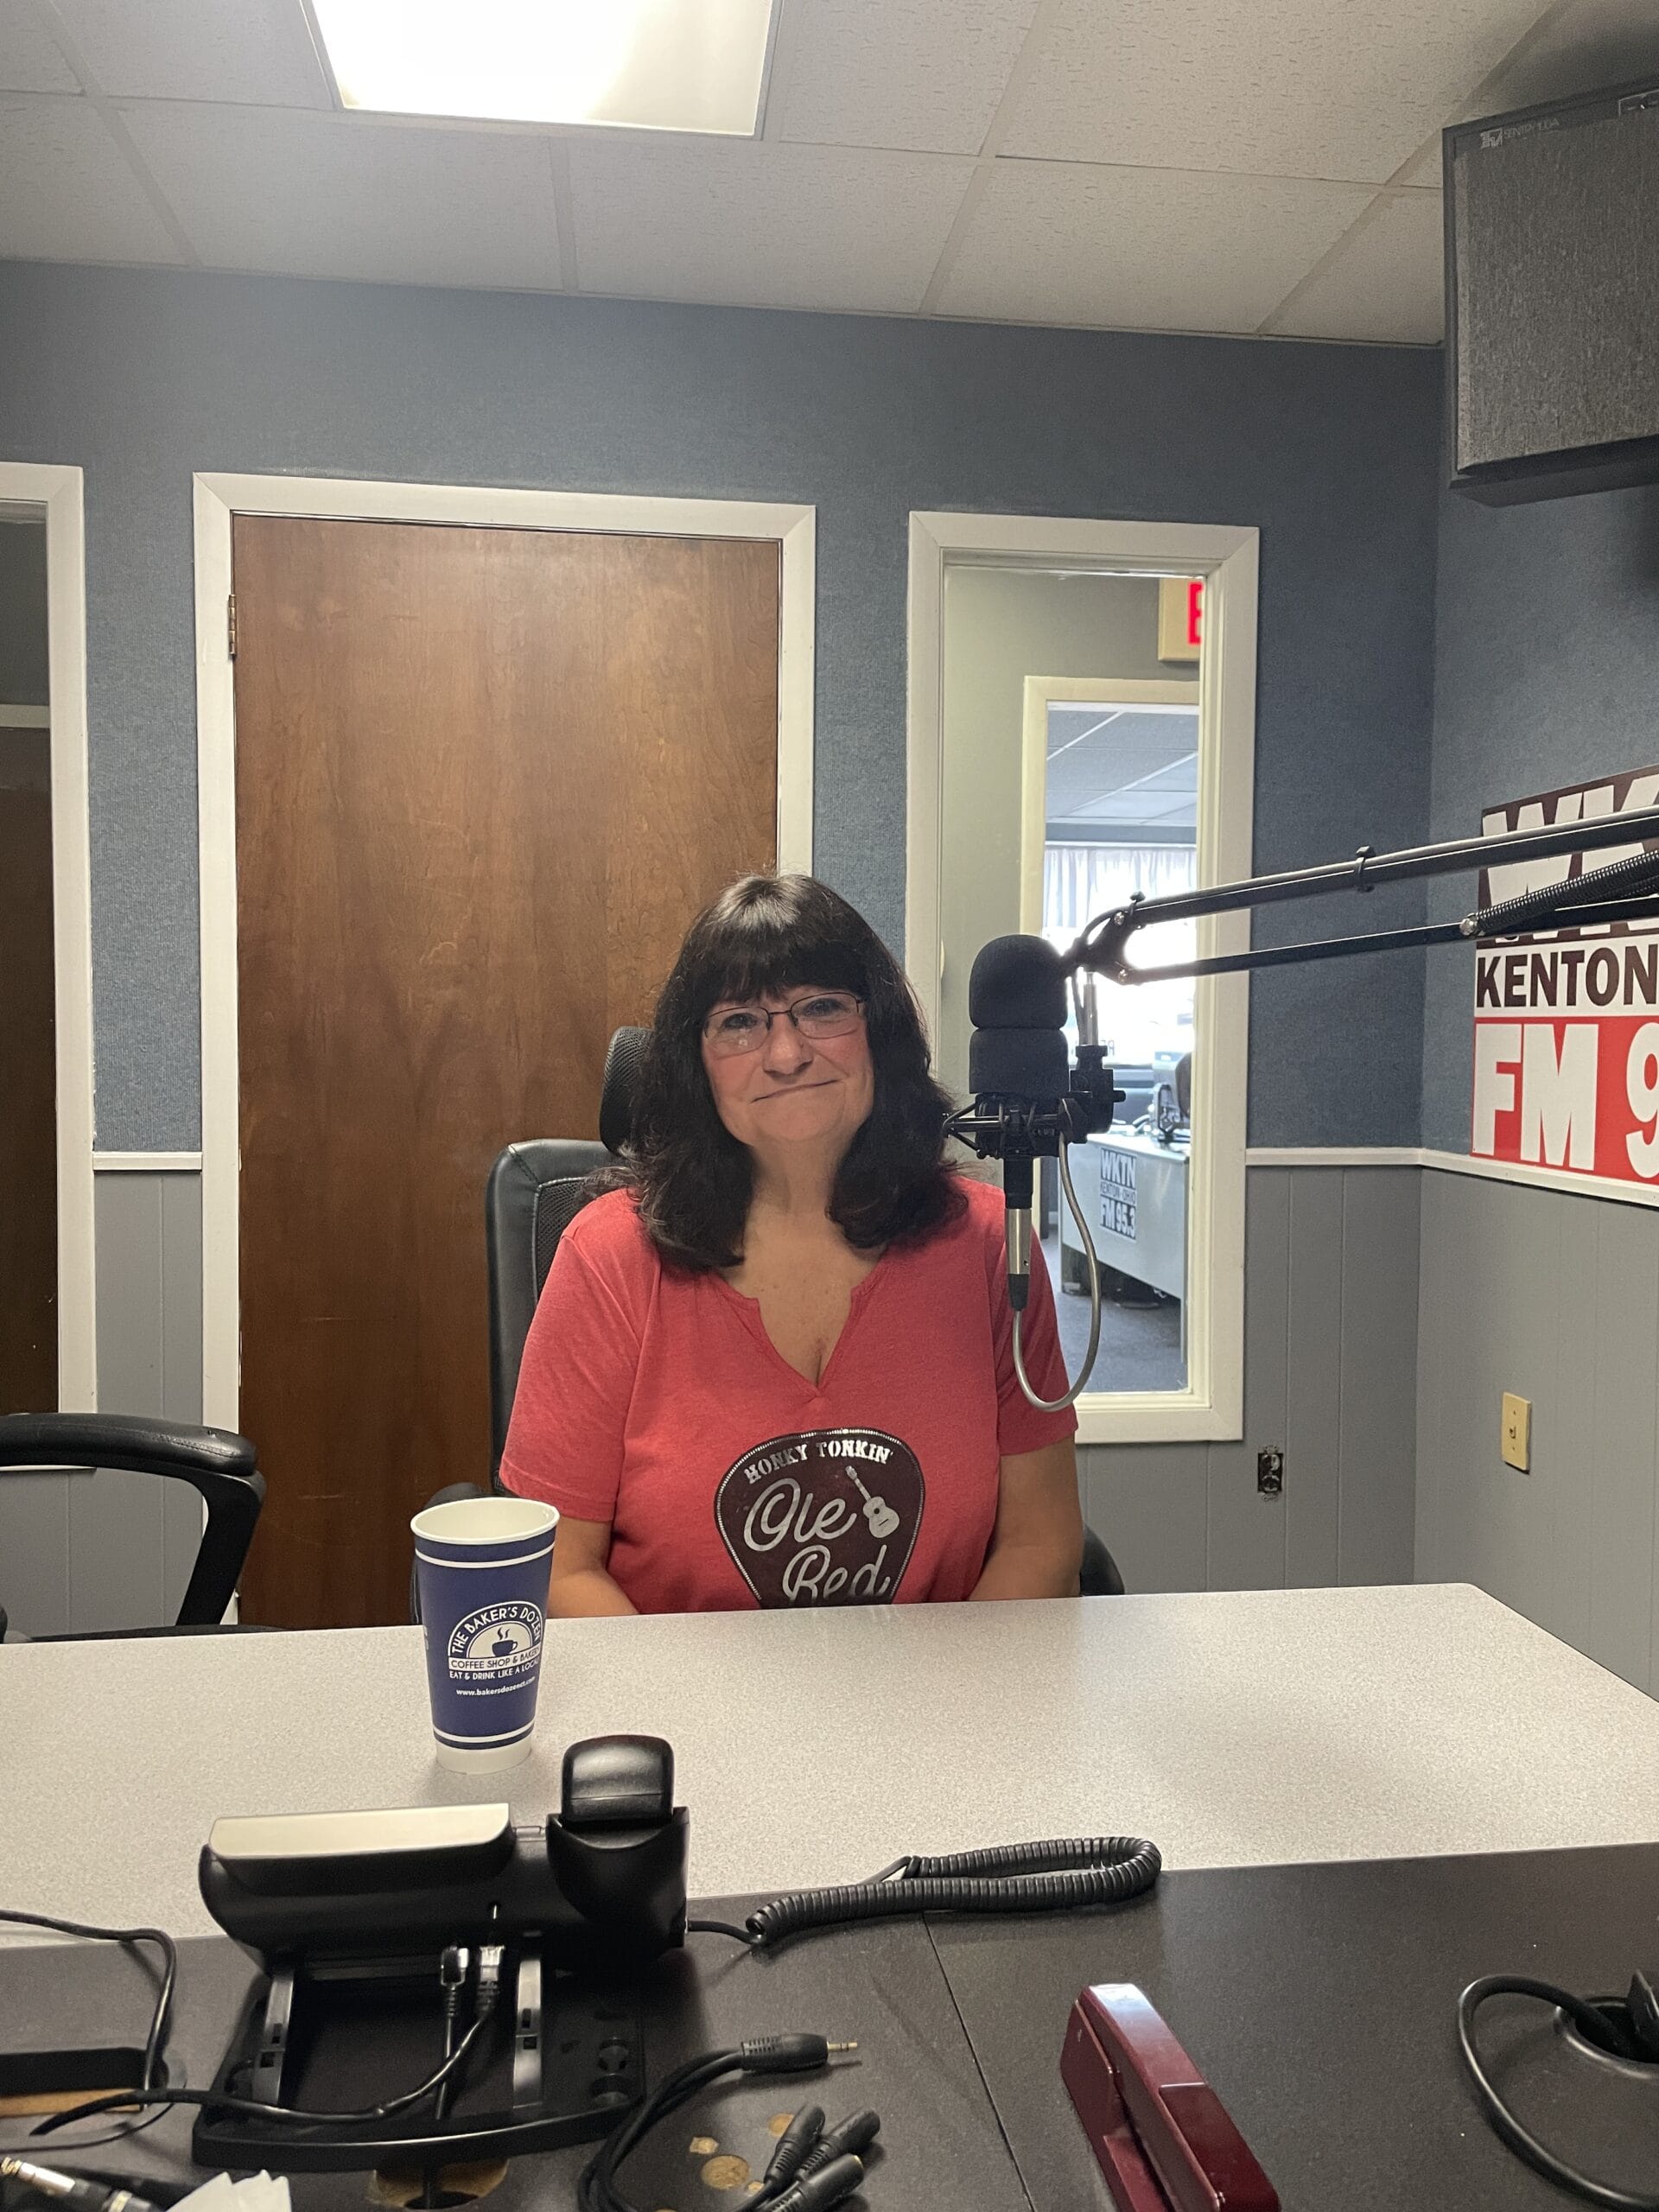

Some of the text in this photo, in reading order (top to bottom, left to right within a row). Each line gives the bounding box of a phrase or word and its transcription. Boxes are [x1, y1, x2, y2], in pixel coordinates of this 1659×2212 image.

[1477, 945, 1659, 1008] KENTON
[1473, 1023, 1599, 1171] FM
[1101, 1148, 1135, 1189] WKTN
[1100, 1197, 1116, 1230] FM
[744, 1440, 893, 1484] HONKY TONKIN'
[744, 1478, 857, 1552] Ole
[782, 1544, 891, 1602] Red
[451, 1631, 469, 1654] THE
[464, 1606, 518, 1634] BAKER'S
[519, 1607, 541, 1642] DOZEN
[449, 1670, 463, 1680] EAT
[464, 1672, 471, 1681] &
[472, 1671, 496, 1681] DRINK
[498, 1668, 514, 1678] LIKE
[514, 1666, 520, 1675] A
[451, 1659, 485, 1669] COFFEE
[486, 1658, 511, 1669] SHOP
[512, 1656, 519, 1664] &
